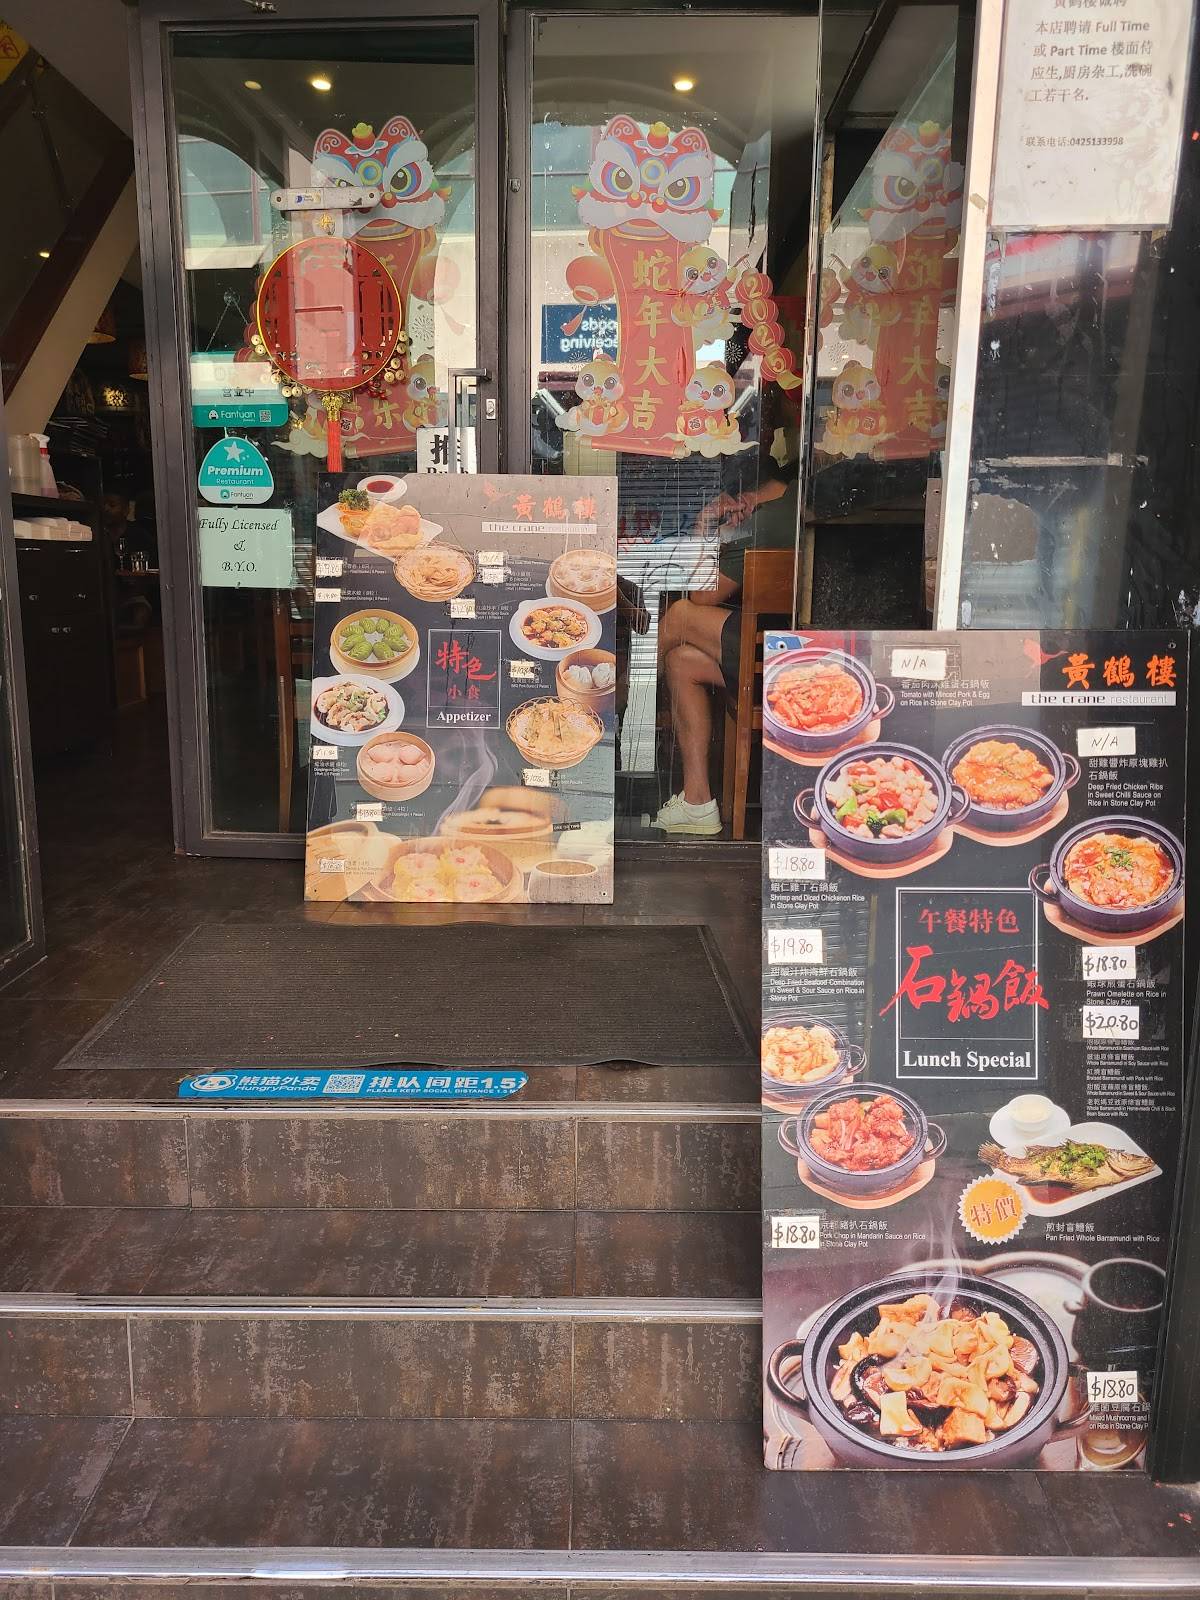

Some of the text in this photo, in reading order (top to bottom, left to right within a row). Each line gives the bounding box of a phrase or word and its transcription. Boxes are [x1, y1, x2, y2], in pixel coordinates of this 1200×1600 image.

[1035, 20, 1150, 35] 本店聘请 Full Time
[1032, 43, 1047, 58] 或
[1050, 46, 1075, 57] Part
[1079, 45, 1107, 56] Time
[631, 249, 673, 430] 蛇年大吉
[220, 410, 256, 420] Fantuan
[207, 465, 264, 477] Premium
[231, 491, 253, 499] Fantuan
[199, 518, 279, 534] Fully Licensed
[233, 540, 246, 551] &
[221, 561, 257, 573] B.Y.O.
[434, 639, 497, 681] 特色
[901, 656, 927, 671] N/A
[1062, 653, 1177, 689] 黃鶴樓
[1031, 693, 1168, 704] the crane restaurant
[436, 711, 492, 724] Appetizer
[1091, 734, 1119, 750] N/A
[1087, 783, 1163, 791] Deep Fried Chicken Ribs
[770, 894, 789, 902] Shrimp
[791, 894, 803, 902] and
[804, 894, 819, 902] Diced
[852, 894, 865, 902] Rice
[777, 902, 793, 910] Stone
[795, 902, 808, 910] Clay
[808, 902, 818, 910] Pot
[918, 908, 1020, 934] 午餐特色
[1084, 955, 1127, 976] $18.80
[829, 979, 864, 987] Combination
[879, 945, 1049, 1023] 石鍋飯
[1086, 990, 1166, 998] Prawn Omelette on Rice in
[1085, 1012, 1138, 1036] $20.80
[903, 1050, 1031, 1071] Lunch Special
[237, 1076, 321, 1087] 熊猫外卖
[971, 1195, 1018, 1226] 特價
[773, 1222, 816, 1247] $18.80
[850, 1232, 855, 1240] in
[857, 1232, 883, 1240] Mandarin
[885, 1232, 903, 1240] Sauce
[904, 1232, 911, 1240] on
[912, 1232, 925, 1240] Rice
[1045, 1234, 1160, 1242] Pan Fried Whole Barramundi with Rice
[844, 1240, 857, 1248] Clay
[858, 1240, 868, 1248] Pot
[1091, 1376, 1135, 1401] $18.80
